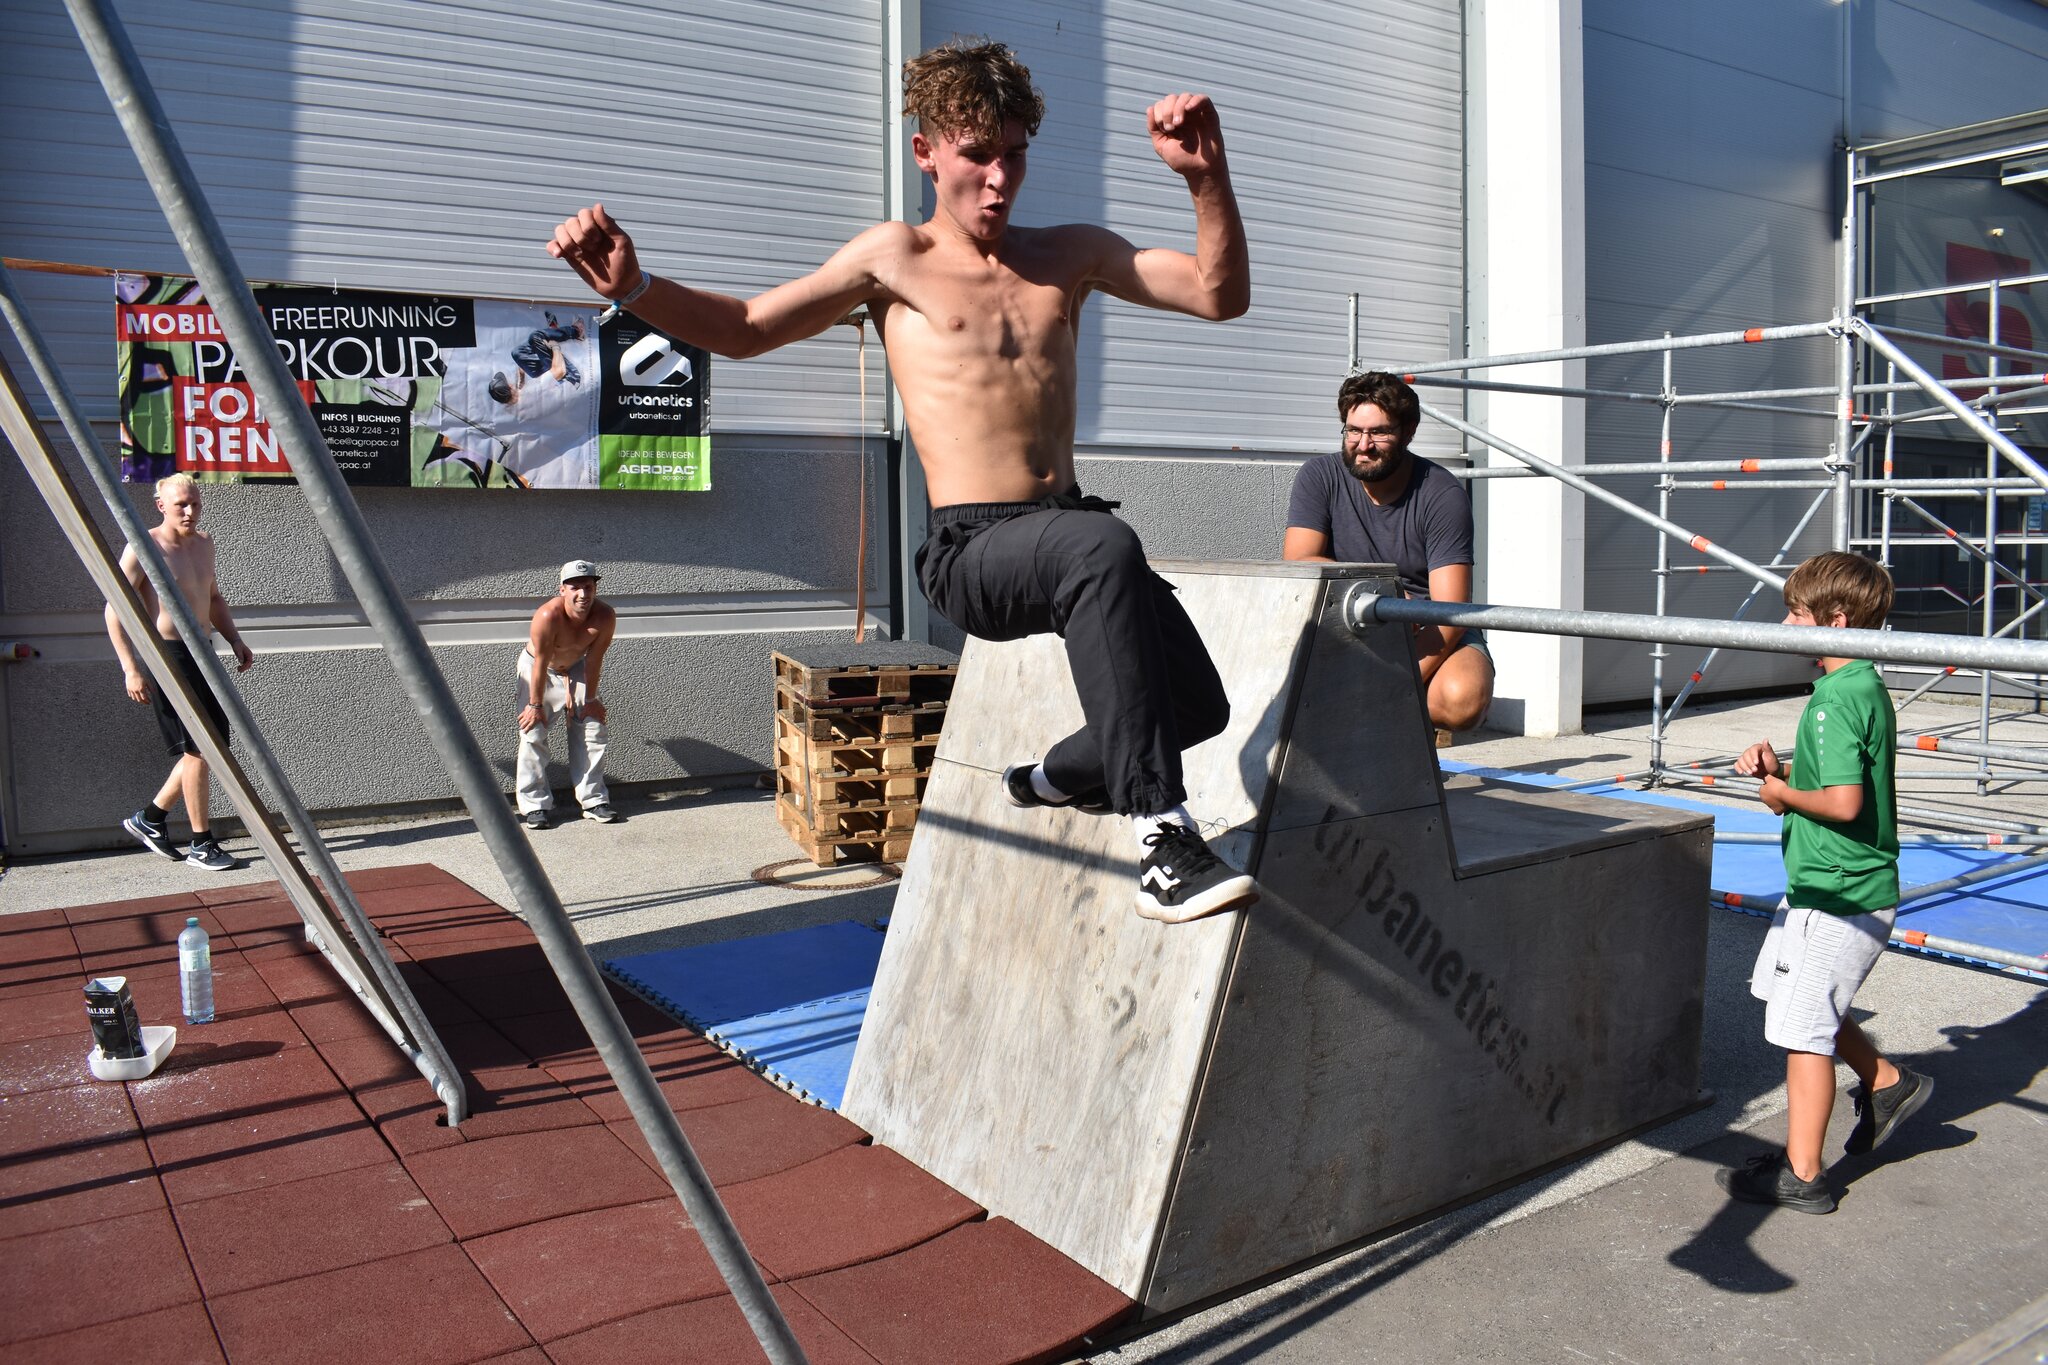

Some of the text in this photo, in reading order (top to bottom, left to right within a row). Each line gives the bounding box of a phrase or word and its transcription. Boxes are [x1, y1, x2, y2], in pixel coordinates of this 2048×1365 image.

[125, 305, 457, 335] MOBIL FREERUNNING
[183, 386, 265, 424] FO
[618, 392, 693, 408] urbanetics
[321, 413, 348, 422] INFOS
[357, 414, 402, 424] BUCHUNG
[629, 411, 682, 421] urbanetics.at
[322, 425, 338, 434] +43
[339, 425, 360, 434] 3387
[361, 426, 382, 435] 2248
[390, 427, 400, 435] 21
[184, 425, 280, 463] REN
[330, 449, 379, 458] banetics.at
[618, 449, 695, 459] IDEEN DIE BEWEGEN
[337, 461, 371, 470] opac.at
